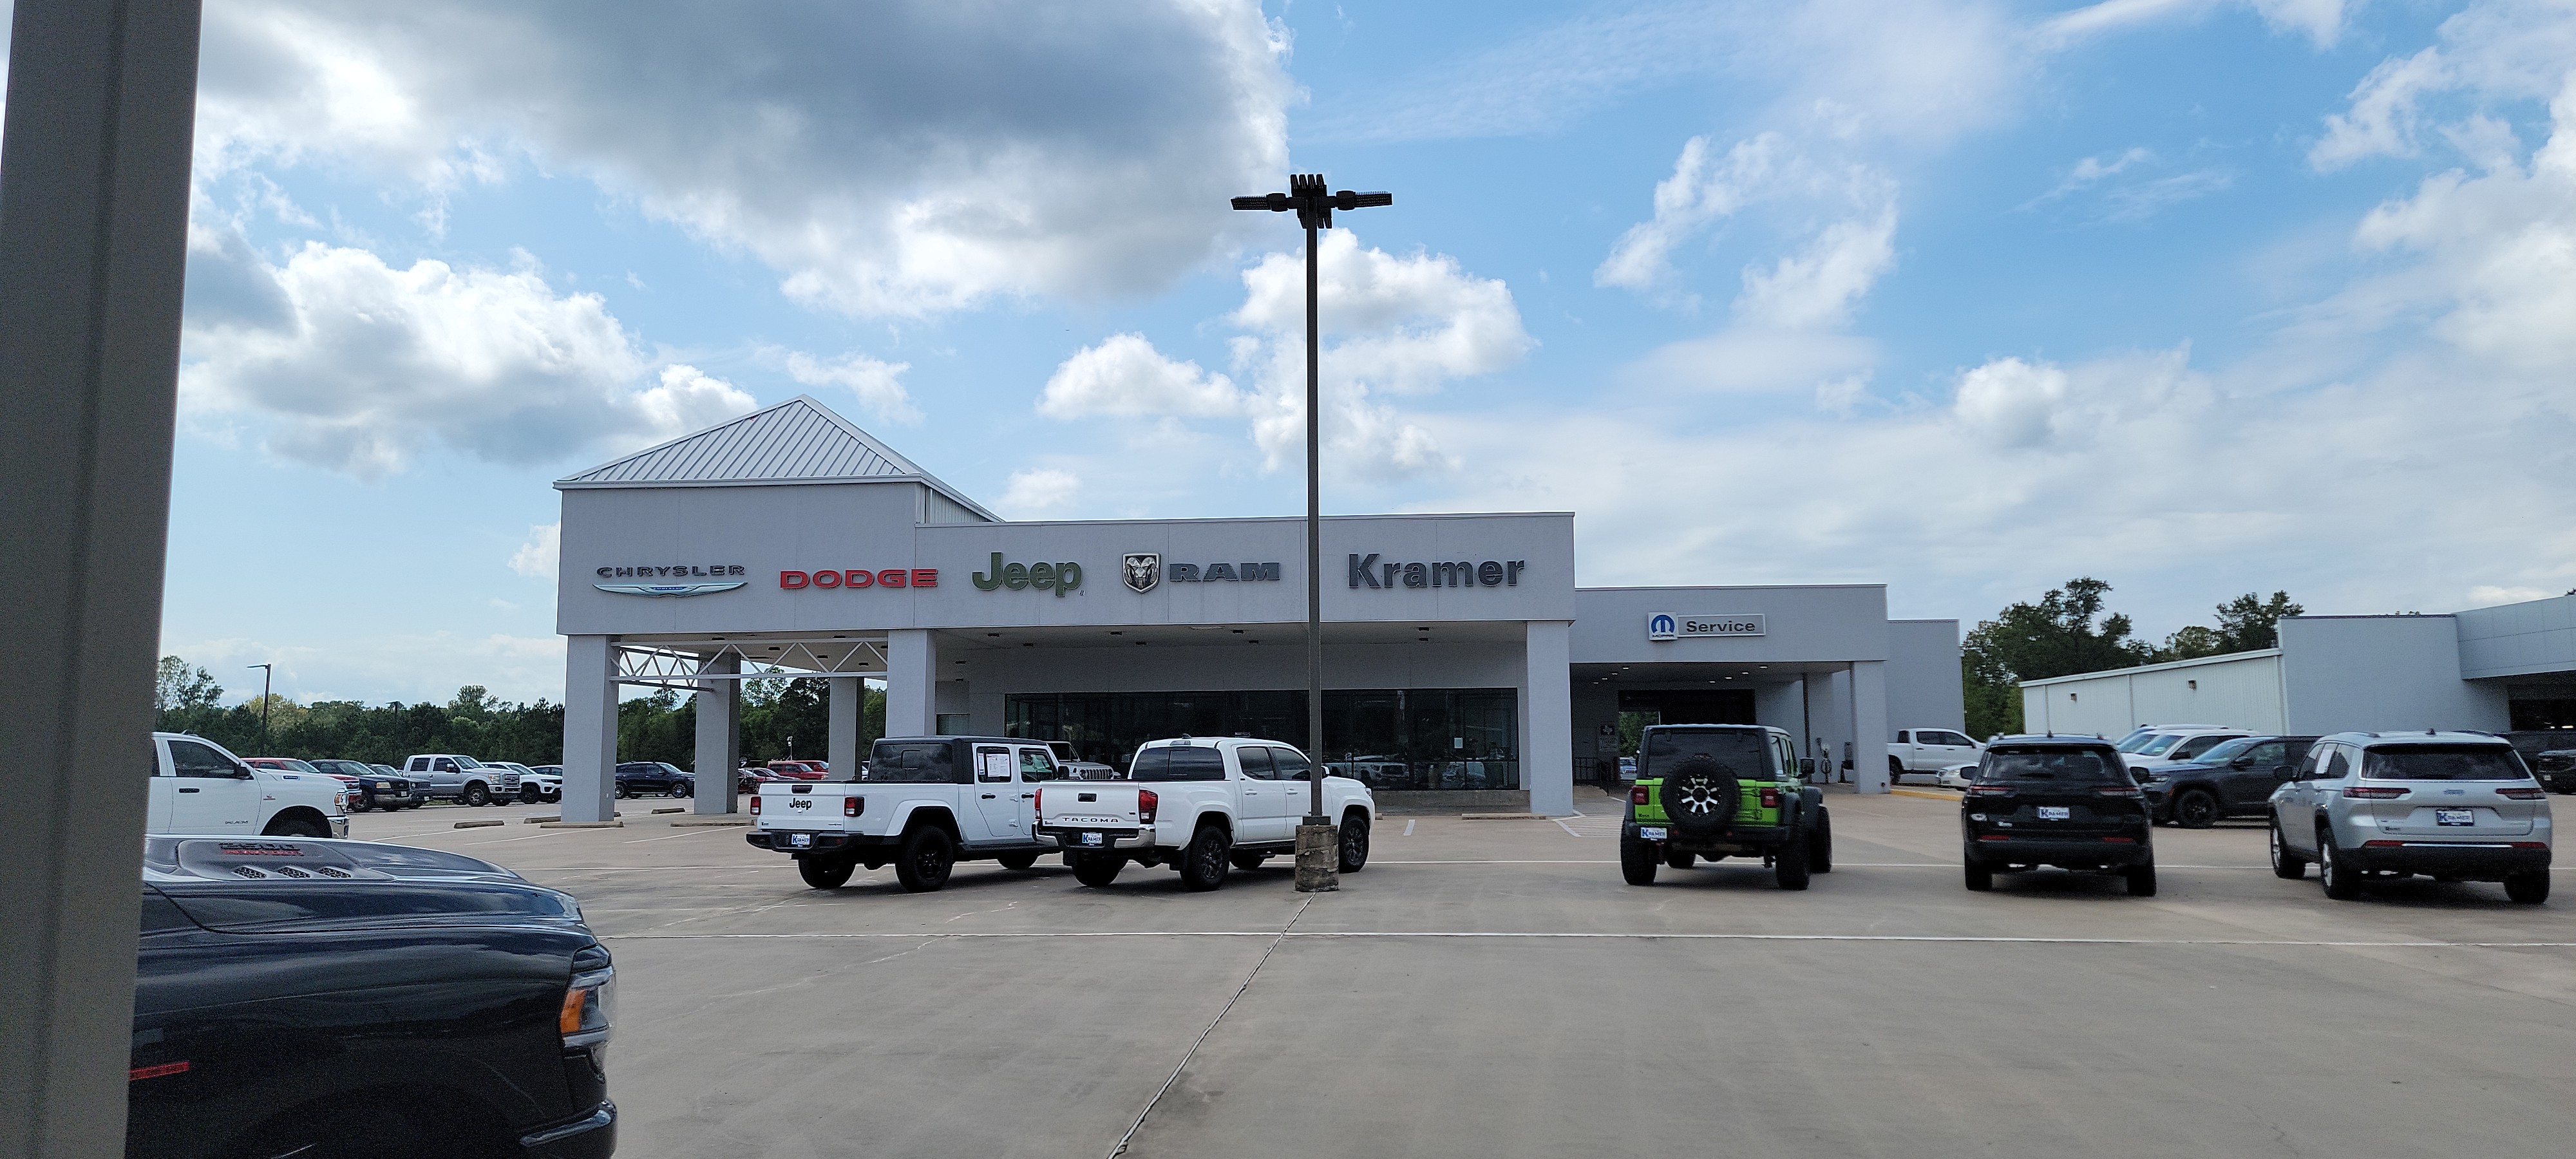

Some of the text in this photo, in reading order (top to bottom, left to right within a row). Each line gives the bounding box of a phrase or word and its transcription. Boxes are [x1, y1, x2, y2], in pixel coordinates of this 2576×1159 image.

[596, 565, 745, 578] CHRYSLER
[779, 569, 938, 589] DODGE
[972, 551, 1083, 597] Jeep
[1169, 562, 1280, 582] RAM
[1348, 552, 1525, 589] Kramer
[1686, 620, 1756, 632] Service
[789, 797, 812, 810] Jeep
